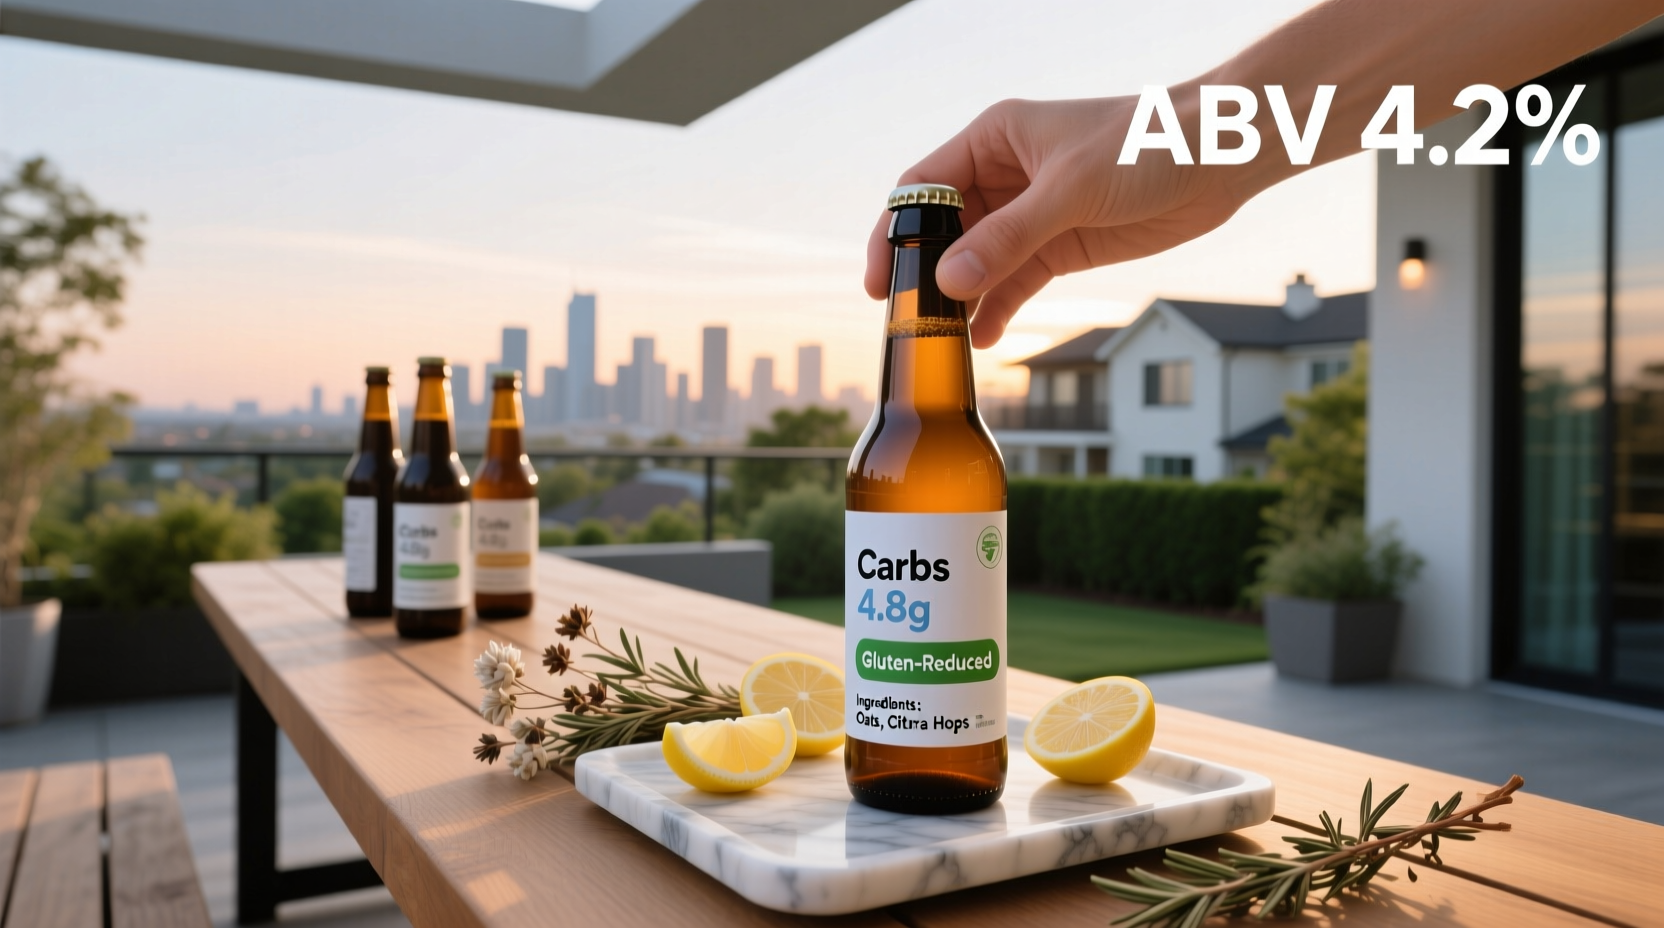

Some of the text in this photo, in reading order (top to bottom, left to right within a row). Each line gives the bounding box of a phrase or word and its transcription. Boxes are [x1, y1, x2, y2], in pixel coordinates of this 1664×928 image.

[857, 548, 950, 582] Carbs
[857, 588, 931, 633] 4.8g
[862, 650, 993, 672] Gluten-Reduced
[856, 711, 884, 731] Oats,
[933, 715, 970, 734] Hops
